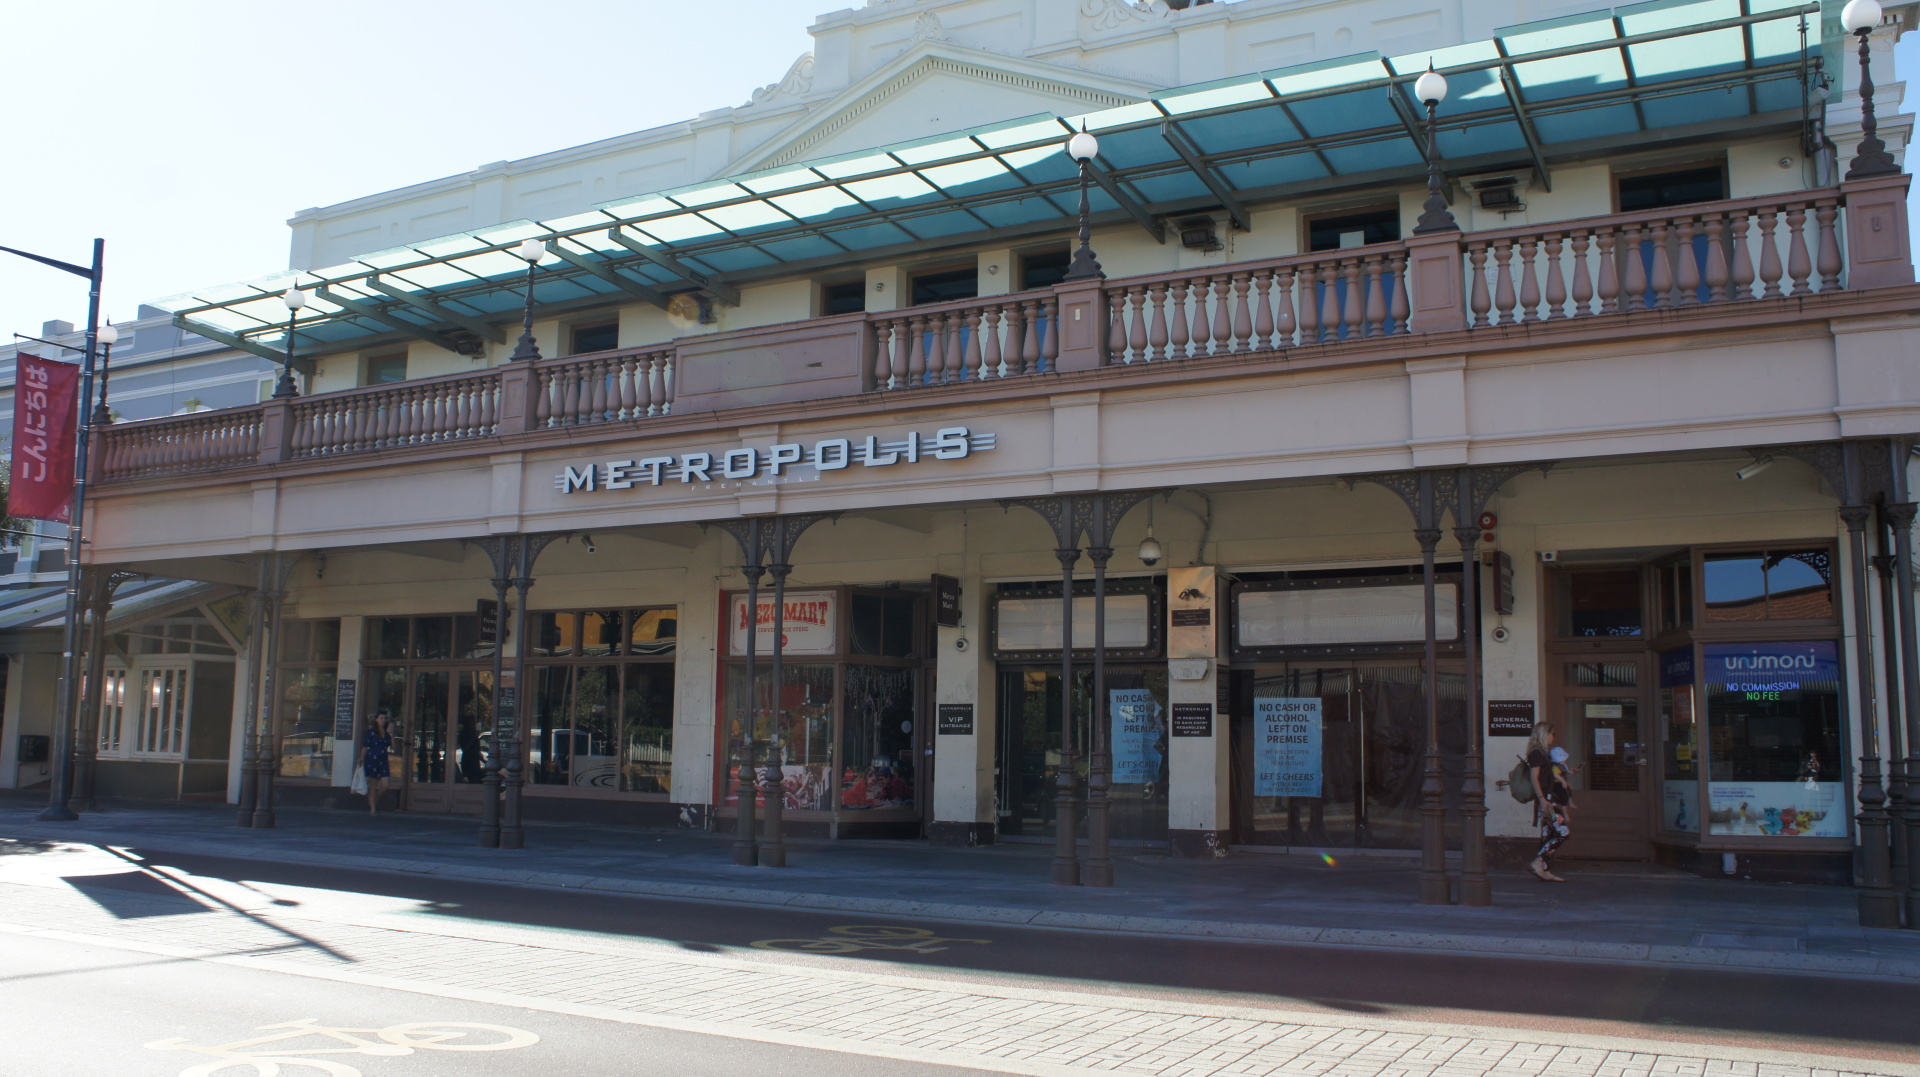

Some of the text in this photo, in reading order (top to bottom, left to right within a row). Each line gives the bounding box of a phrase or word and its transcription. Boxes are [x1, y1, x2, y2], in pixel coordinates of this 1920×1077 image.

[22, 364, 48, 482] こんにちは
[563, 427, 969, 494] METROPOLIS
[691, 475, 820, 492] FREMANTLE
[783, 601, 828, 627] MART
[1725, 648, 1816, 670] unimoni
[1726, 681, 1800, 692] NO COMMISSION
[1116, 694, 1153, 703] NO CASH
[1746, 691, 1780, 701] NO FEE
[1122, 704, 1156, 713] ALCOHO
[1259, 703, 1317, 712] NO CASH OR
[1125, 714, 1146, 723] LEFT
[1265, 714, 1310, 723] ALCOHOL
[1268, 724, 1307, 733] LEFT ON
[1267, 735, 1309, 744] PREMISE
[1118, 761, 1138, 769] LET'S
[1260, 772, 1315, 781] LET'S CHEERS
